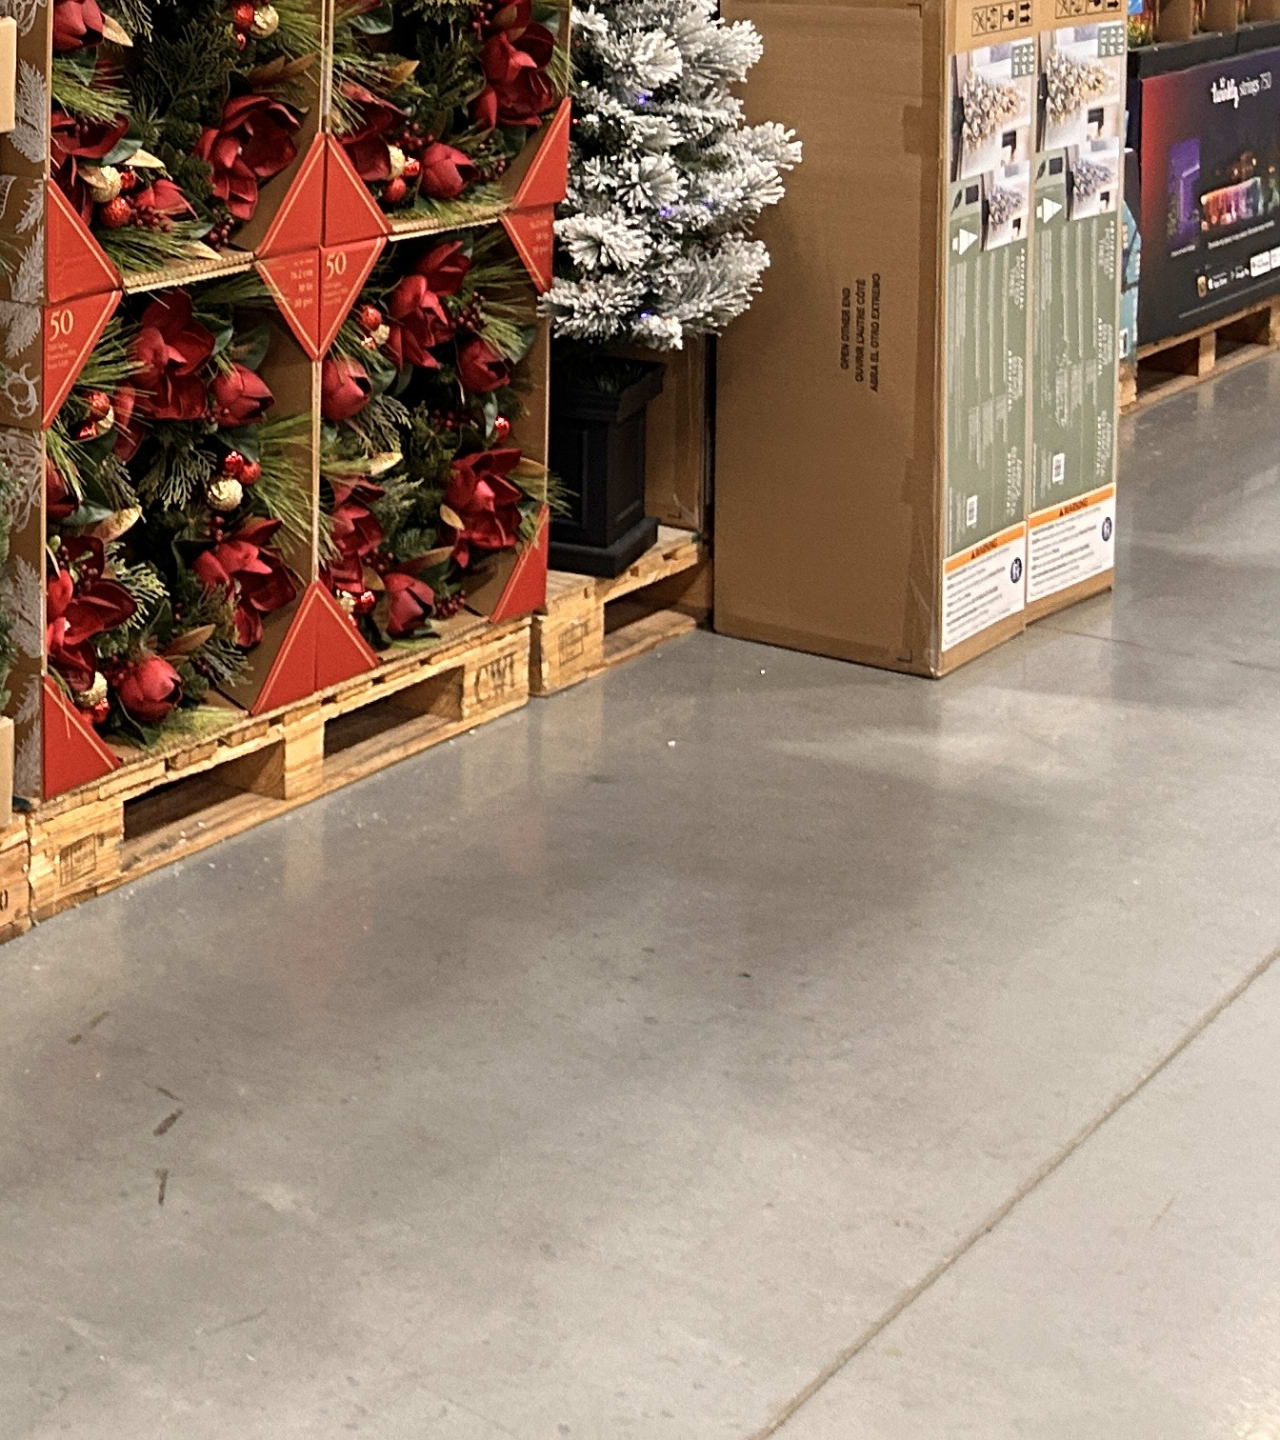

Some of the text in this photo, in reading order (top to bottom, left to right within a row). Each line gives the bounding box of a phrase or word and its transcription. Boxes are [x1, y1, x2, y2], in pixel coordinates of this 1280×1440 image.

[1210, 71, 1272, 109] twinkly strings 750
[326, 251, 347, 280] 50
[49, 309, 73, 342] 50
[840, 288, 850, 370] OPEN OTHER END
[870, 273, 880, 392] ABRA EL OTRO EXTREMO
